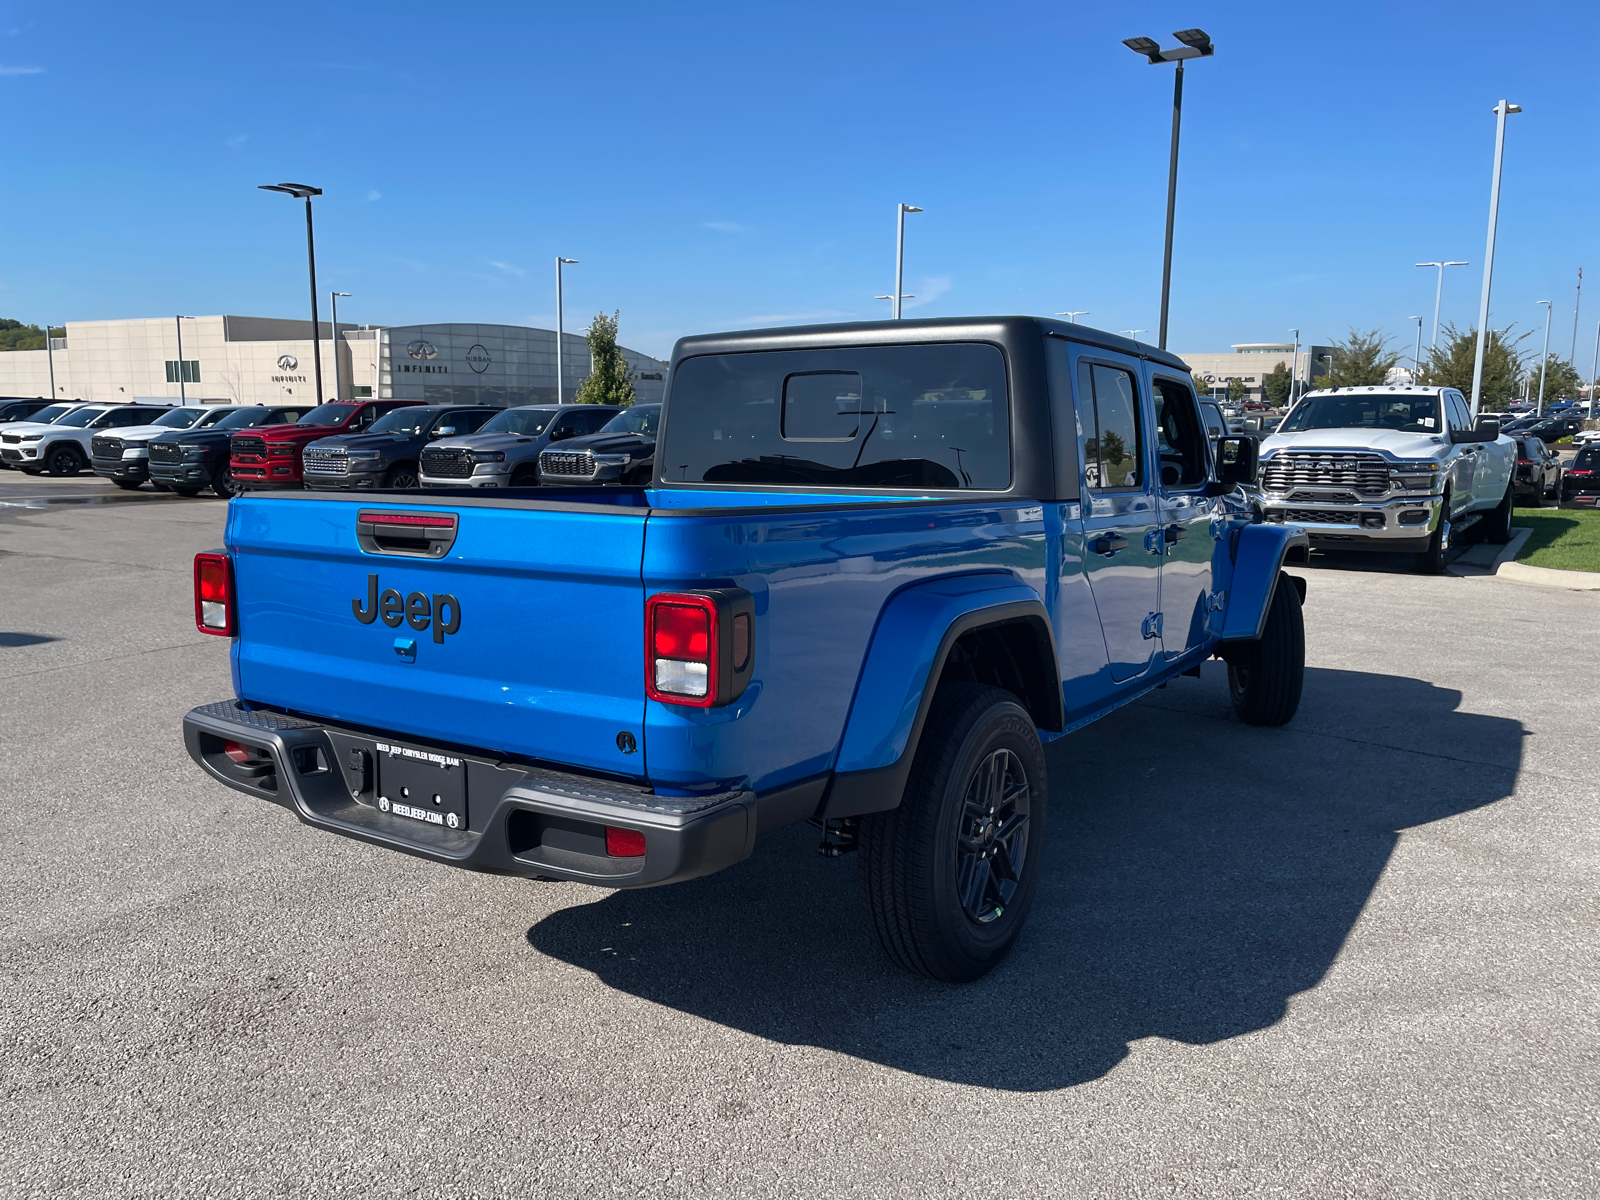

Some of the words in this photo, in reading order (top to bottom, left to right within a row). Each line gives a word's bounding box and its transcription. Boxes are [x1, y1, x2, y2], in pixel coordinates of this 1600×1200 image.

[397, 364, 448, 373] INFINITI
[271, 375, 306, 383] INFINITI
[1294, 460, 1357, 470] RAM
[351, 573, 462, 644] Jeep
[376, 742, 390, 752] REED
[390, 745, 402, 755] JEEP
[402, 747, 428, 761] CHRYSLER
[428, 753, 446, 764] DODGE
[445, 756, 460, 767] RAM
[392, 803, 443, 825] REEDJEEP.COM
